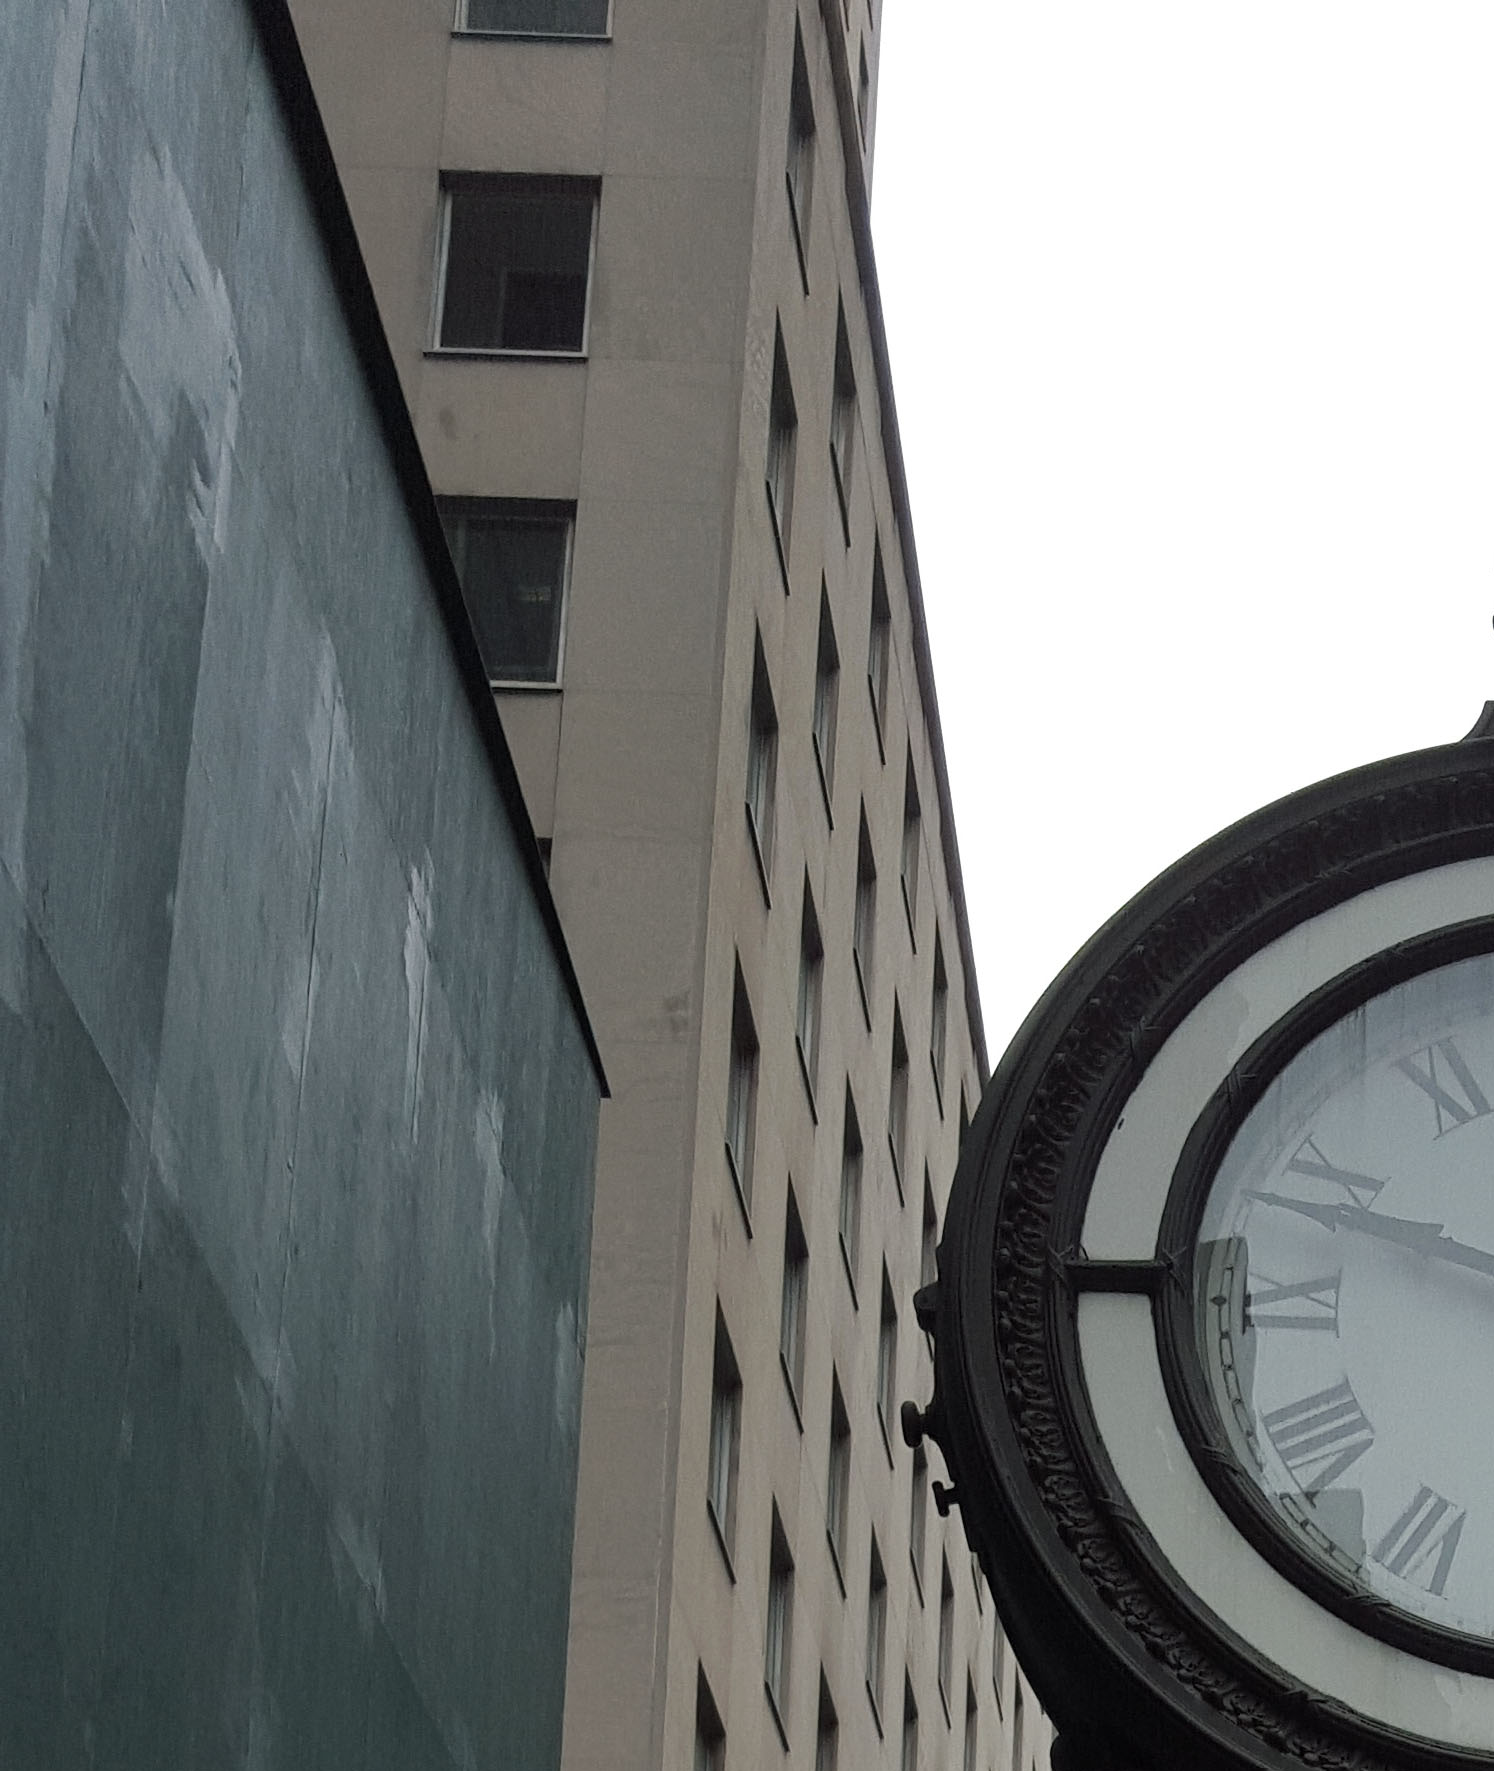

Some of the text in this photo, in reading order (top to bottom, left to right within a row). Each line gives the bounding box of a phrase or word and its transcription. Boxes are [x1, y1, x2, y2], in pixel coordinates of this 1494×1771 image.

[1284, 1134, 1391, 1211] X
[1243, 1266, 1342, 1338] IX
[1262, 1373, 1374, 1507] VIII
[1372, 1484, 1467, 1601] VII
